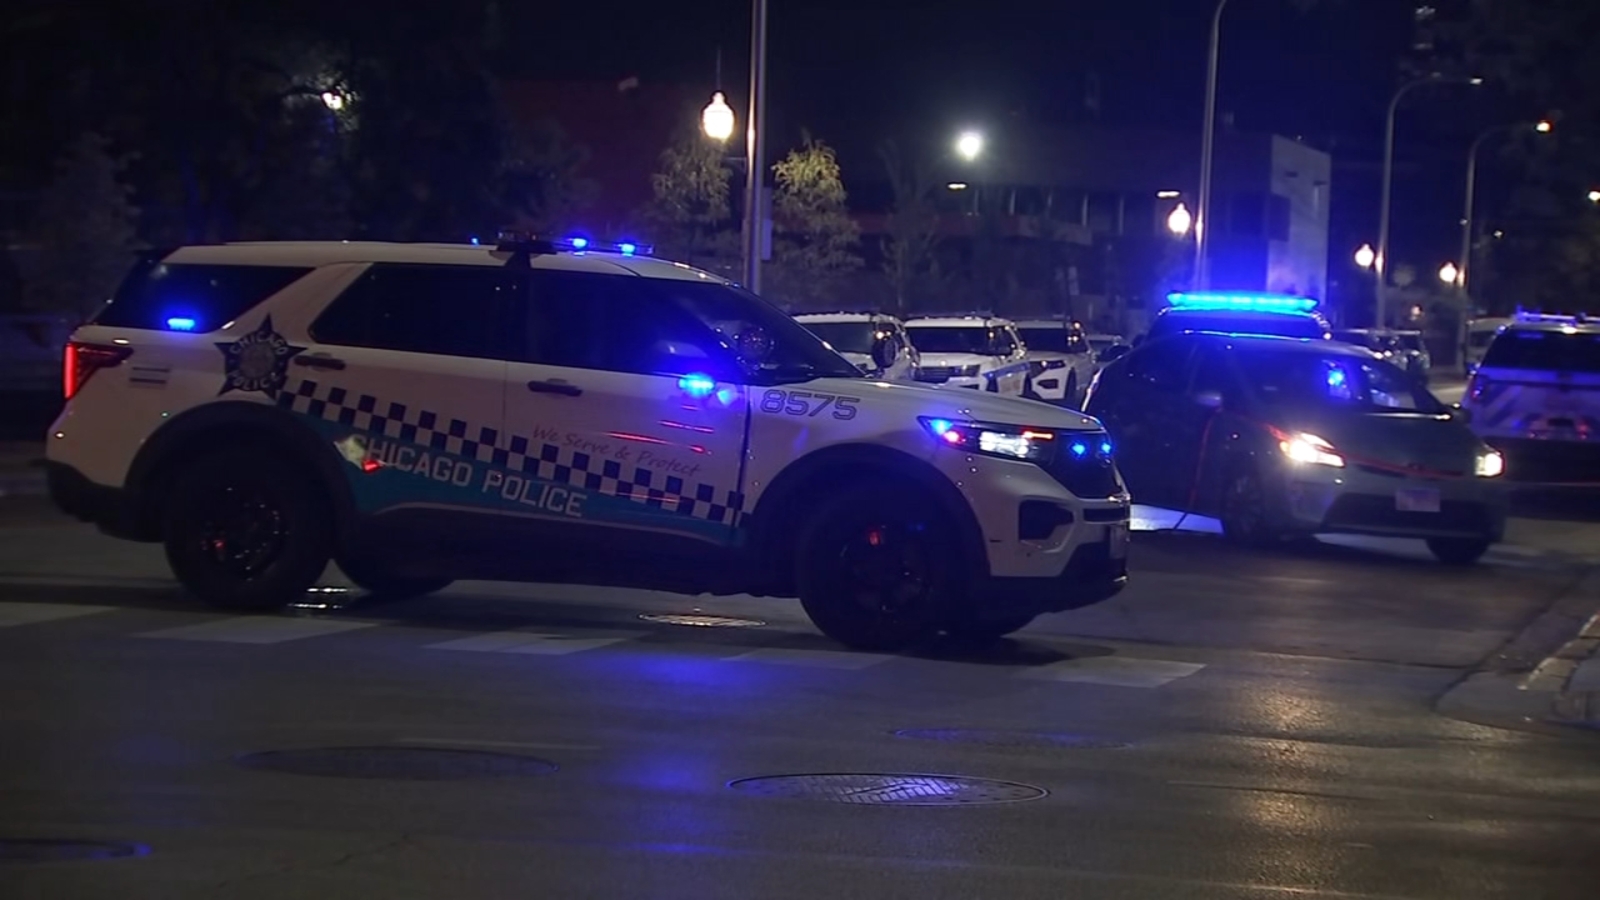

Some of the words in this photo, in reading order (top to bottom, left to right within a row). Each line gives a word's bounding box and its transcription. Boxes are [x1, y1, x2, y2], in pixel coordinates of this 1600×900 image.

[229, 330, 289, 355] CHICAGO
[228, 370, 280, 391] POLICE
[760, 389, 861, 420] 8575
[533, 424, 558, 442] We
[562, 432, 609, 455] Serve
[615, 445, 631, 460] &
[636, 450, 703, 477] Protect
[481, 469, 588, 518] POLICE
